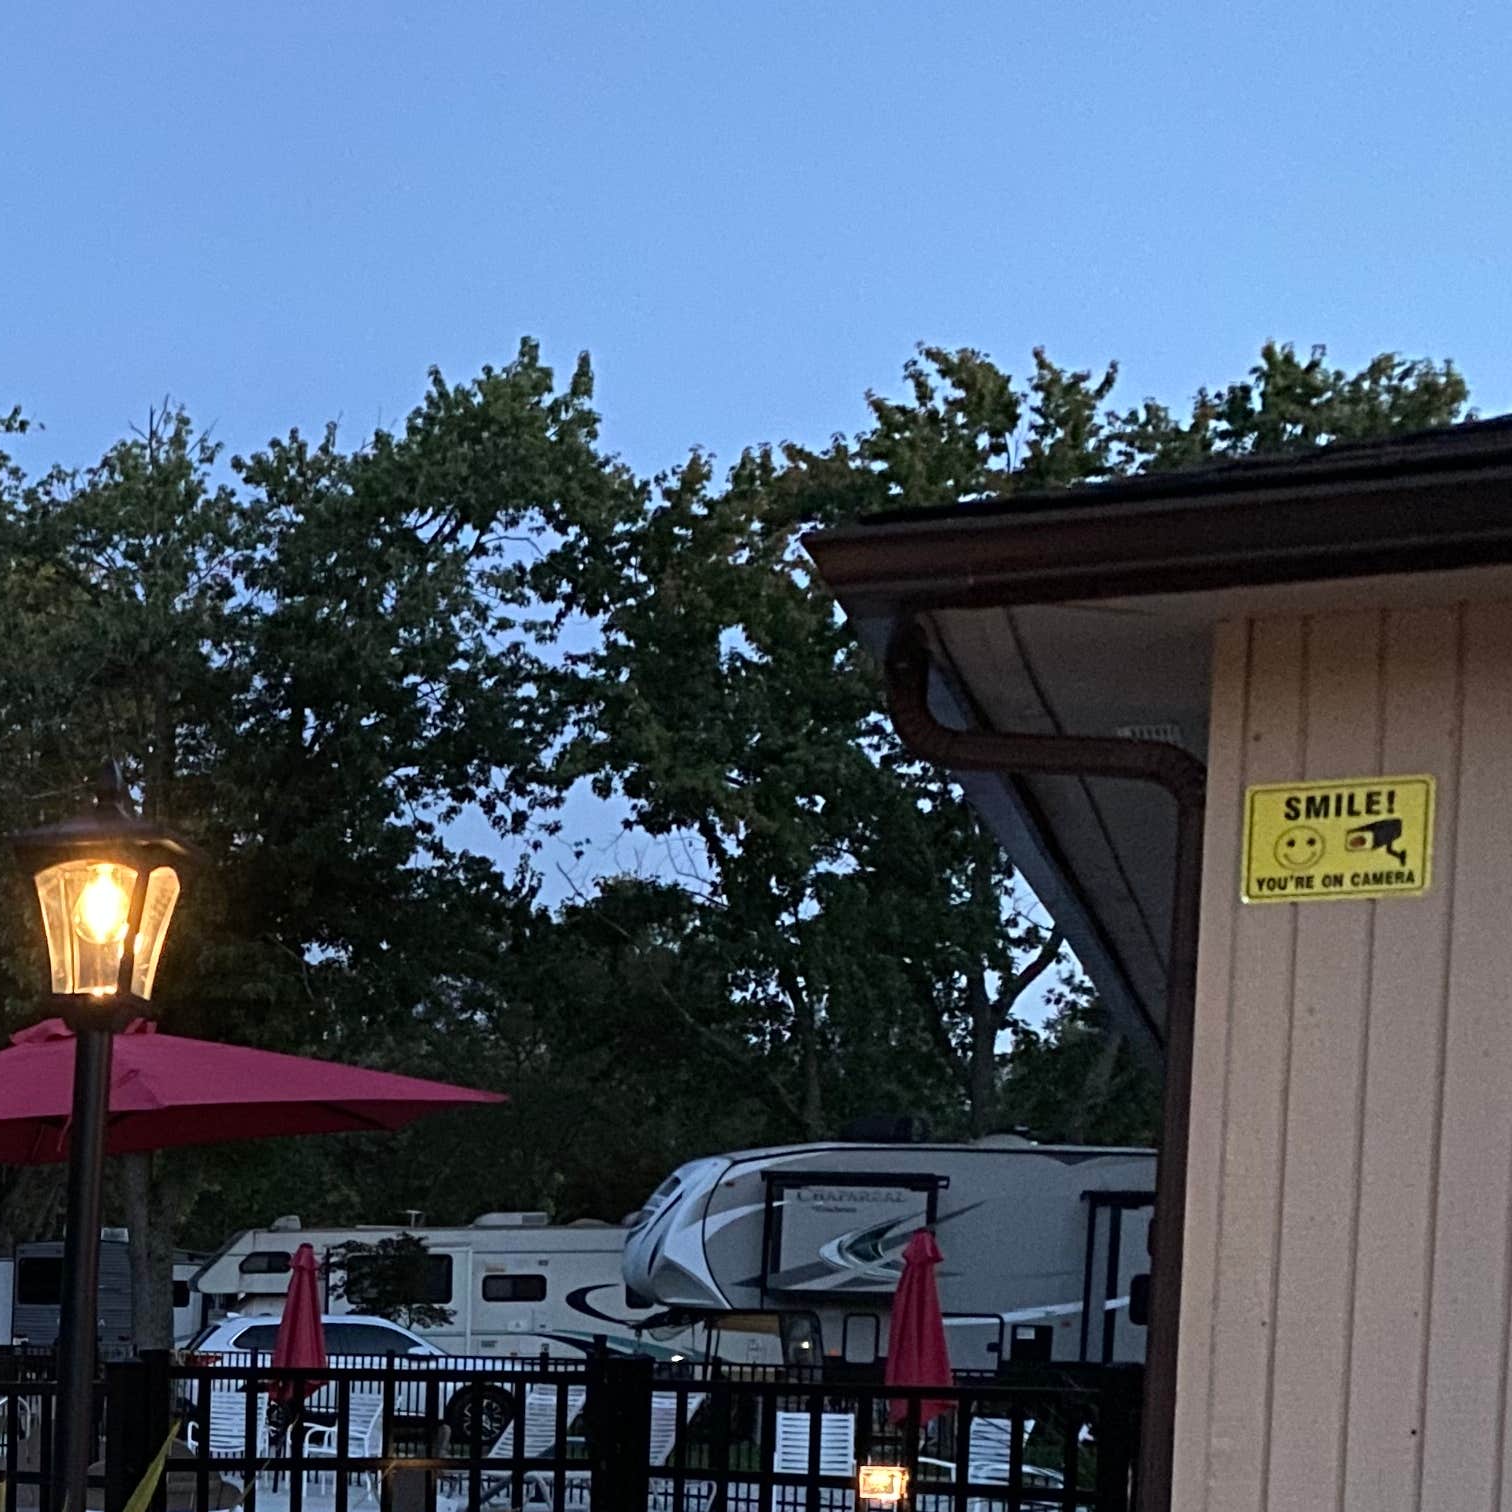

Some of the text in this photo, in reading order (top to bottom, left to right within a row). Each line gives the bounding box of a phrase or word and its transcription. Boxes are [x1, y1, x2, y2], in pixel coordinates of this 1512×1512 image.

[1284, 790, 1396, 821] SMILE!
[1256, 869, 1416, 892] YOU'RE ON CAMERA
